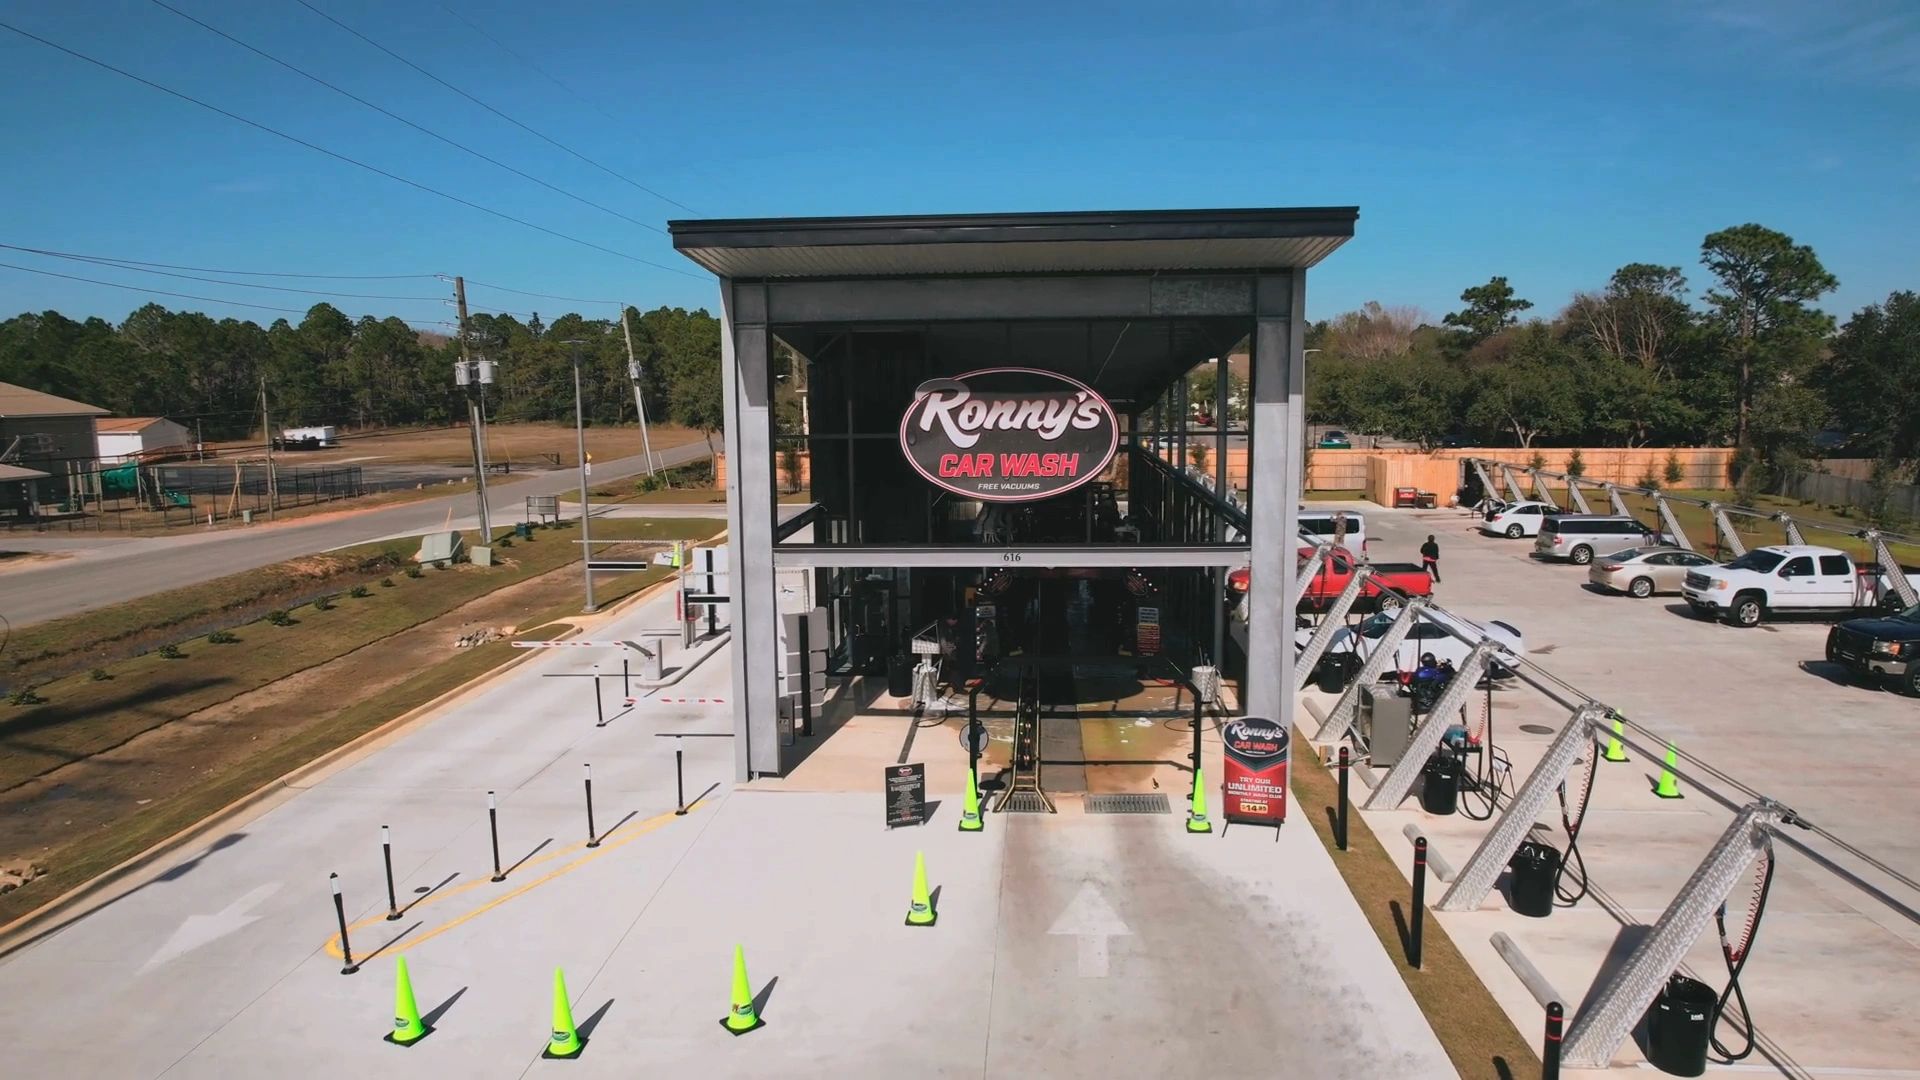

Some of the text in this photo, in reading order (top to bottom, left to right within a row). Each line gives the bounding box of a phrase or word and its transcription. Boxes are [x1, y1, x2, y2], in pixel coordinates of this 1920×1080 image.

[915, 377, 1102, 449] Ronny's
[938, 453, 1079, 478] CAR WASH
[1003, 553, 1021, 562] 616
[1230, 720, 1284, 741] Ronny's
[1233, 741, 1278, 752] CAR WASH
[1227, 782, 1282, 794] UNLIMITED
